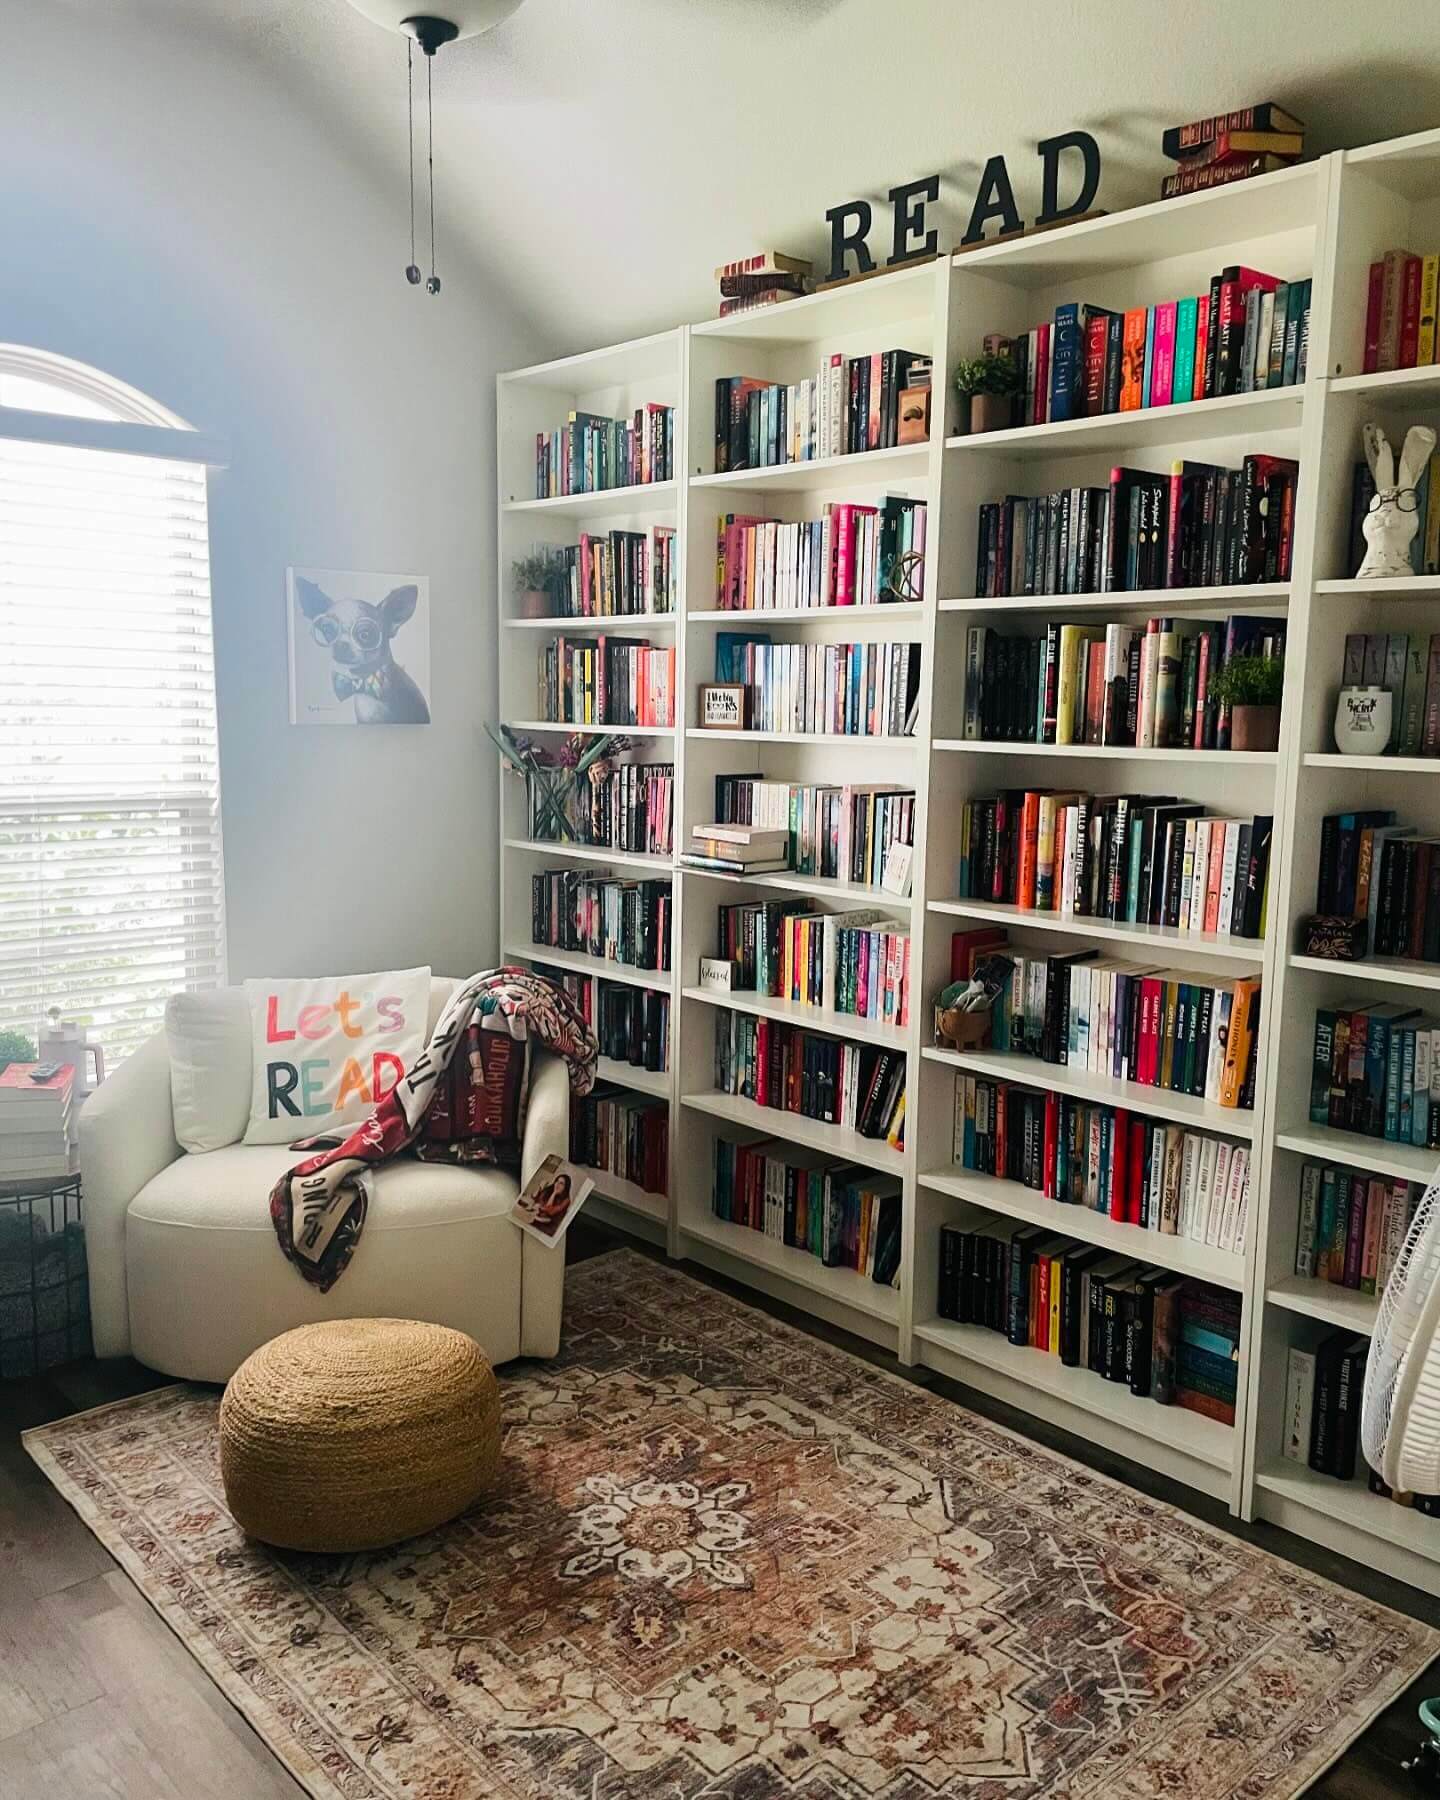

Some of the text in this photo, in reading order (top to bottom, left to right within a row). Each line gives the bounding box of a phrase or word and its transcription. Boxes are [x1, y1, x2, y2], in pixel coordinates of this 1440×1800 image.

[824, 130, 1101, 283] READ
[1223, 295, 1231, 318] LAST
[1221, 319, 1230, 345] PARTY
[1152, 489, 1162, 527] Snapped
[1076, 805, 1086, 876] HELLO BEAUTIFUL
[1316, 1024, 1331, 1061] AFTER
[266, 1052, 405, 1119] READ
[1164, 1188, 1175, 1220] FLOWER
[1390, 1193, 1405, 1236] Adelaide
